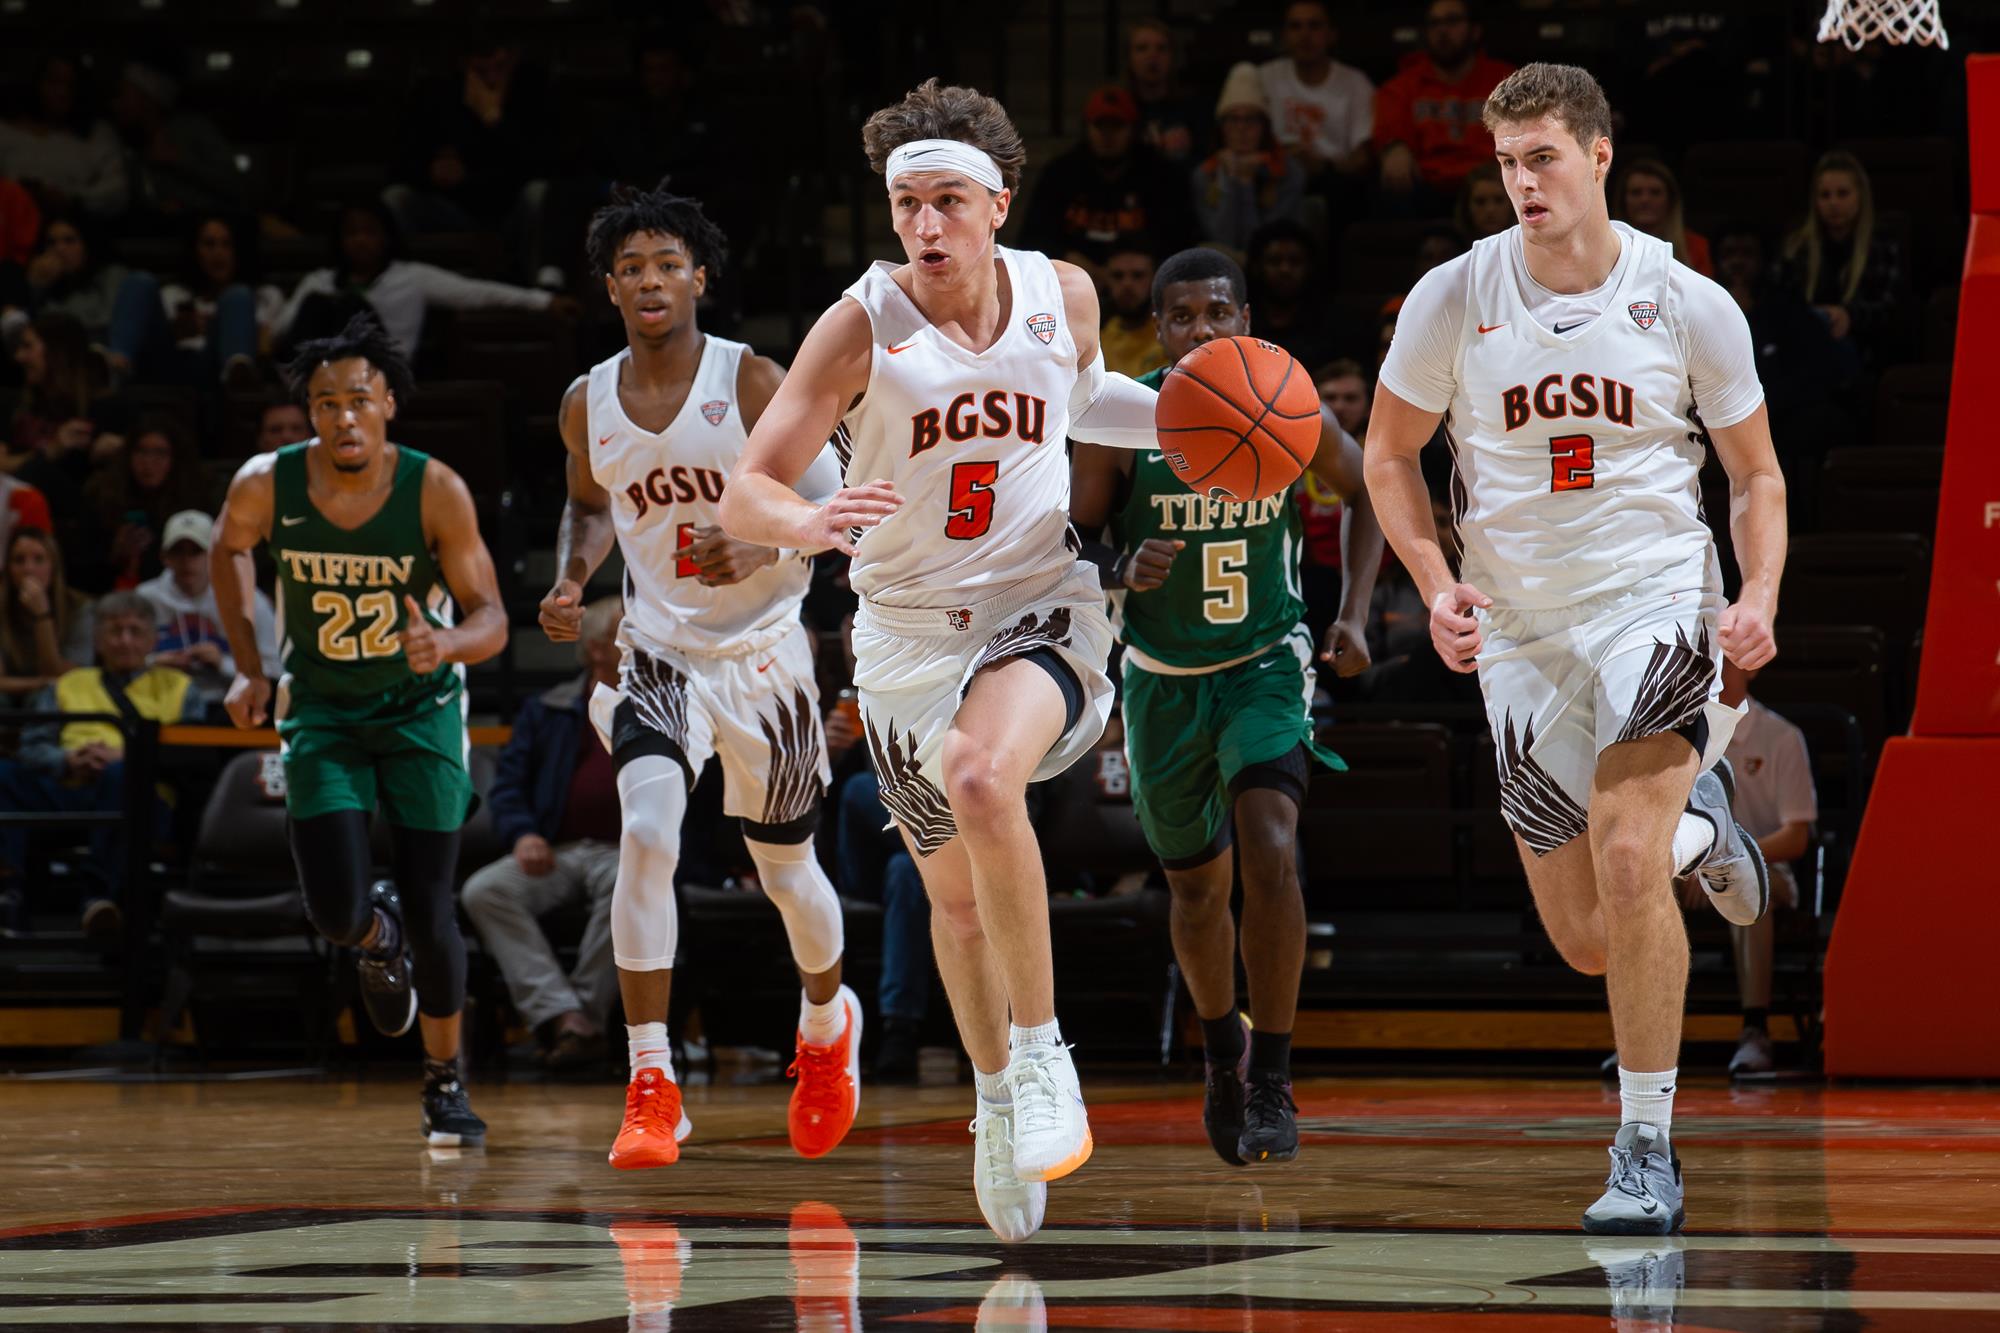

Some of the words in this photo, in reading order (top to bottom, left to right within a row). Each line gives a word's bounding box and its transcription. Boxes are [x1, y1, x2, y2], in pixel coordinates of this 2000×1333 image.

[908, 389, 1047, 459] BGSU
[1501, 373, 1635, 432] BGSU
[625, 464, 725, 521] BGSU
[1549, 433, 1595, 493] 2
[944, 460, 1000, 541] 5
[1151, 487, 1288, 531] TIFFIN
[281, 548, 415, 587] TIFFIN
[1202, 539, 1248, 624] 5
[312, 590, 401, 661] 22
